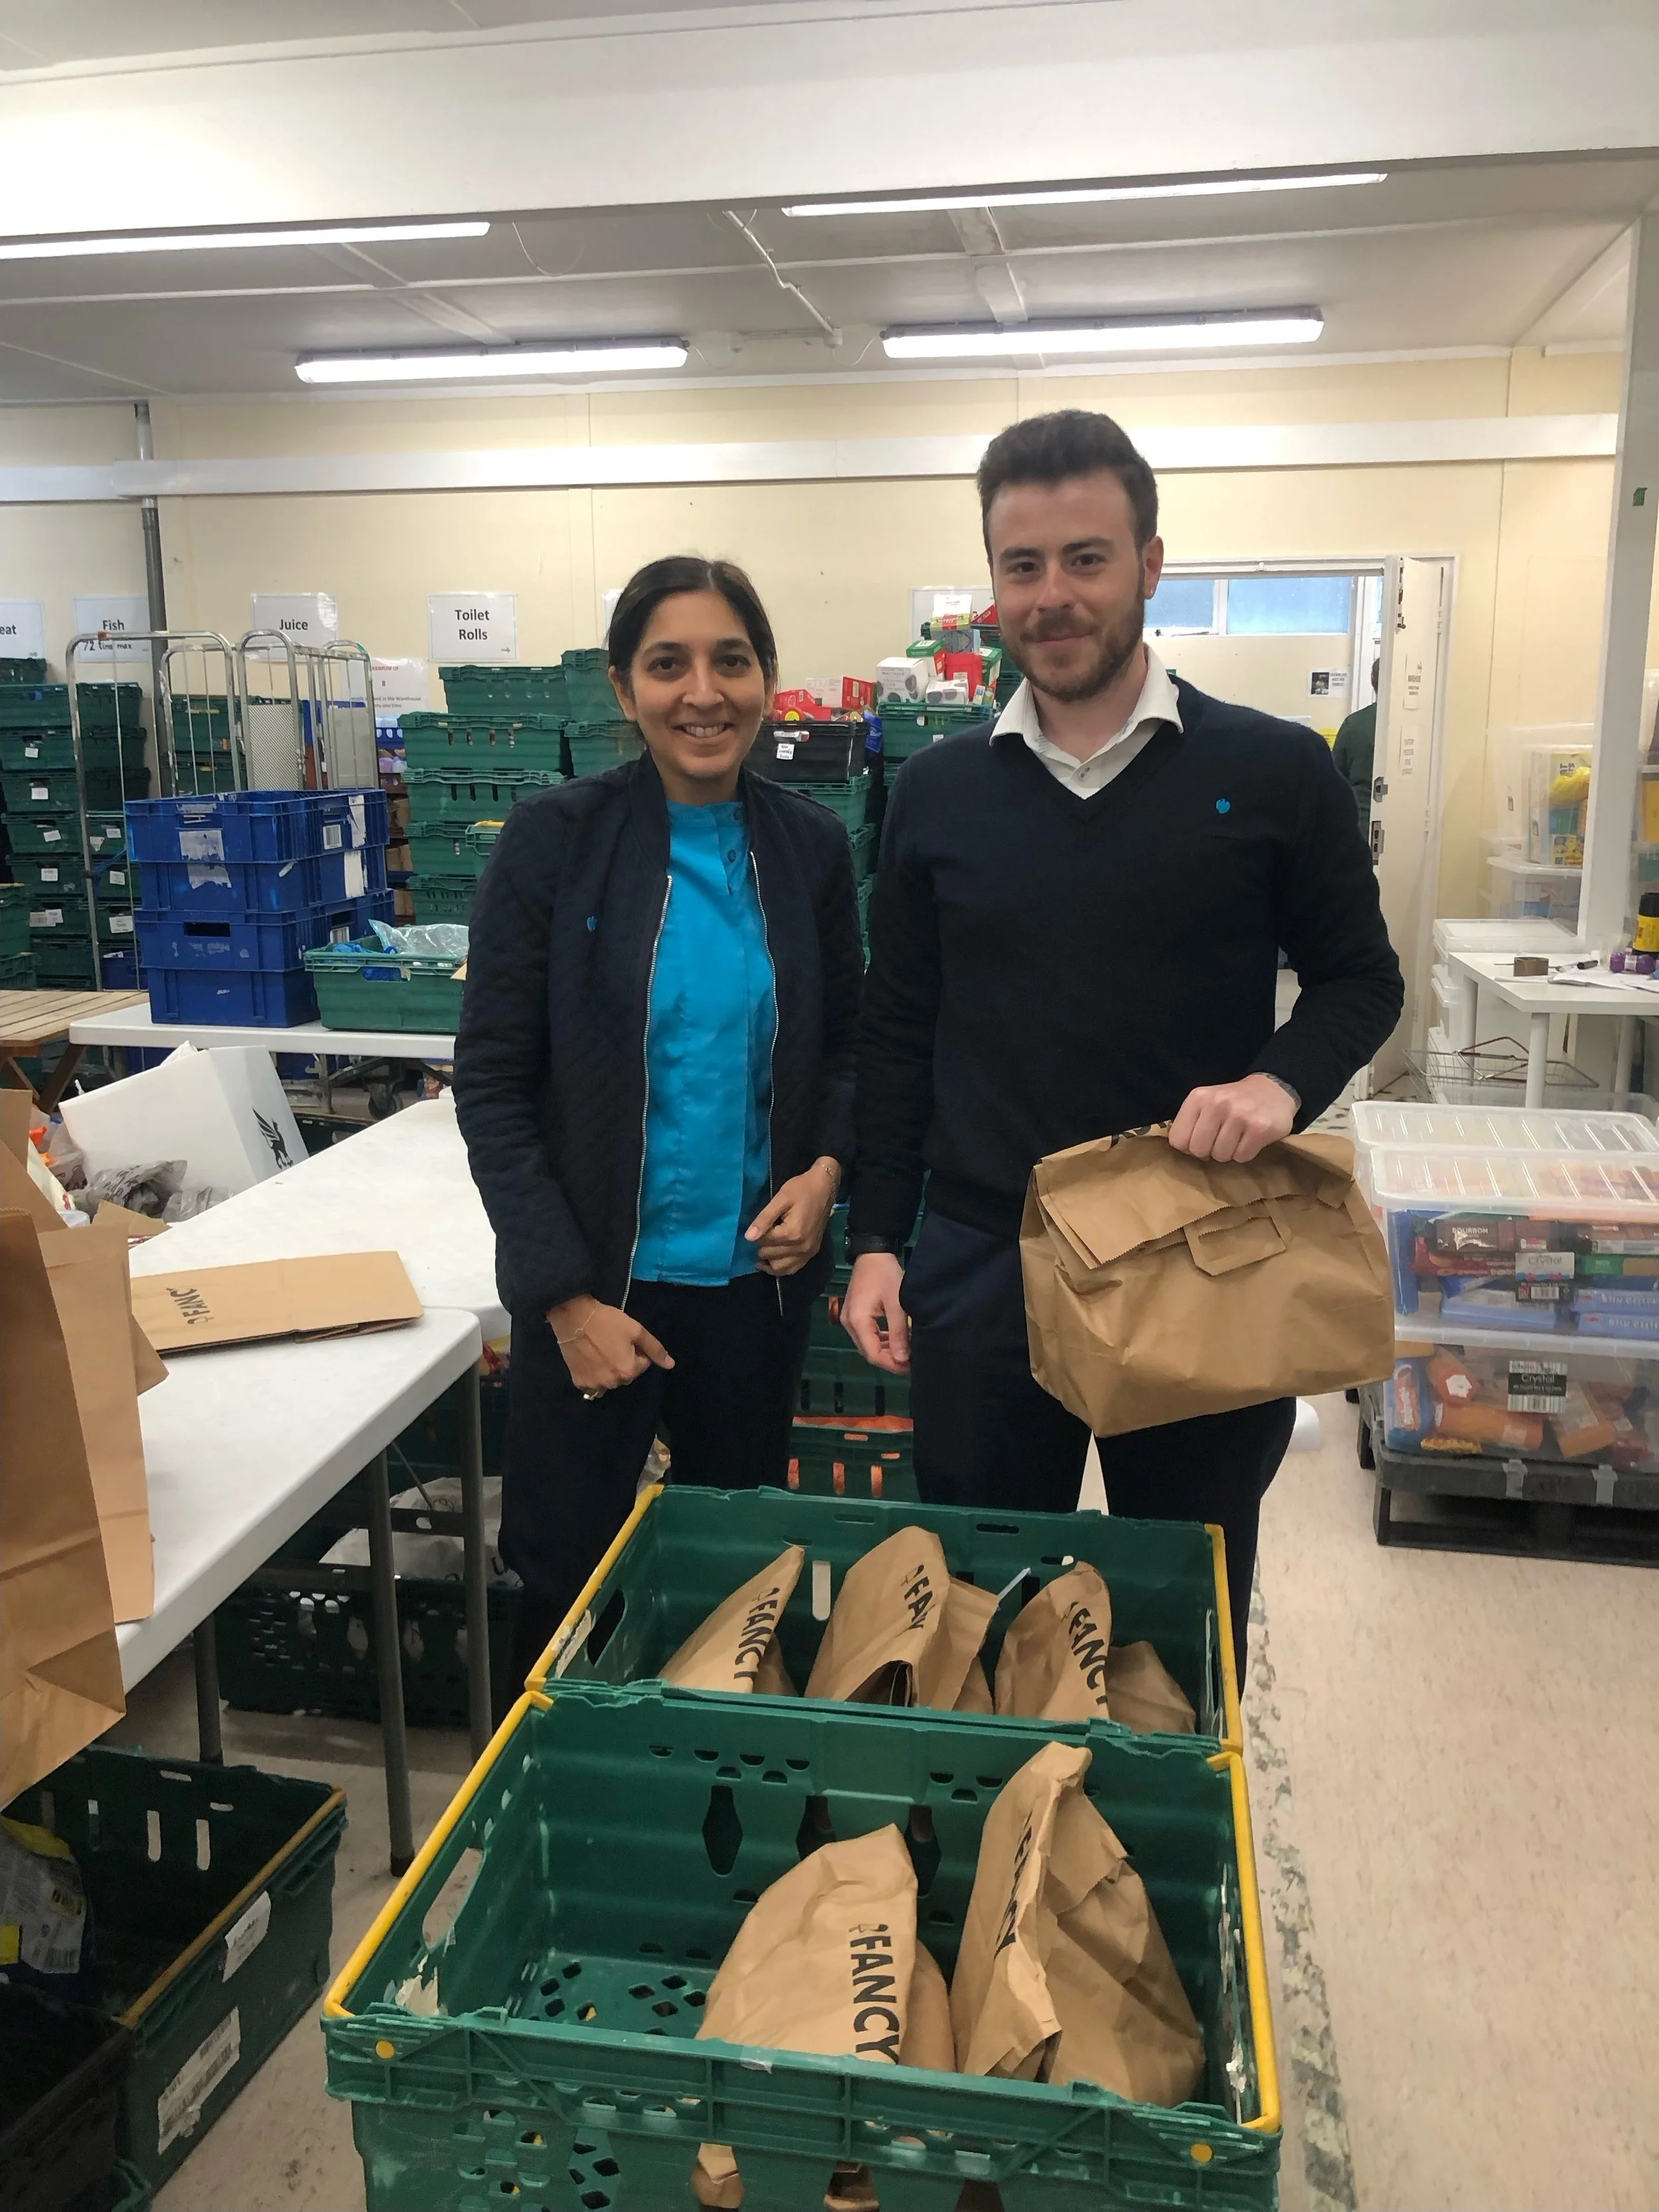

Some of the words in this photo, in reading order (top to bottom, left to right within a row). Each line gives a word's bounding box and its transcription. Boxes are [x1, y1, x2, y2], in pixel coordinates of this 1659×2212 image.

[455, 609, 490, 621] Toilet
[102, 619, 125, 631] Fish
[279, 619, 309, 631] Juice
[459, 629, 488, 640] Rolls
[1528, 1255, 1562, 1267] Crystal
[1522, 1372, 1555, 1385] Crystal
[849, 1935, 900, 2065] FANCY
